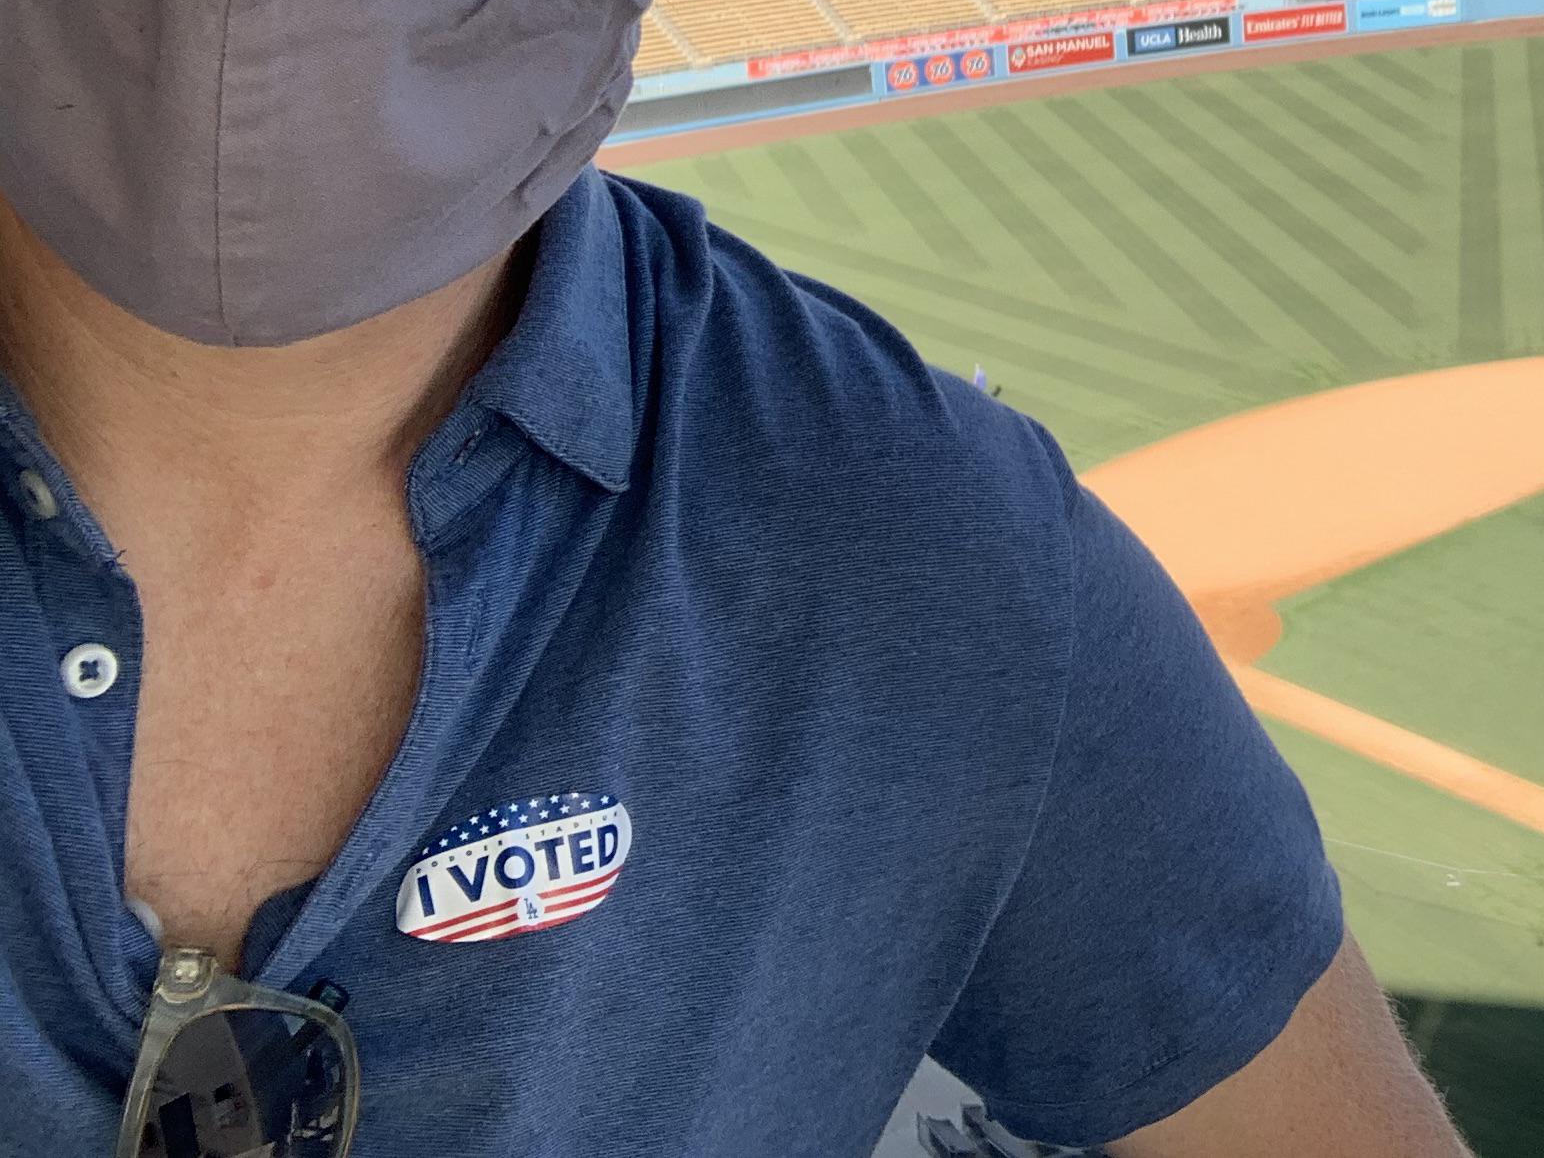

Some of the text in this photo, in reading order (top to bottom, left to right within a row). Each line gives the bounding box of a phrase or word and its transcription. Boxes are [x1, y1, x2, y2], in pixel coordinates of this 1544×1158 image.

[1026, 34, 1110, 58] SAN MANUEL
[1140, 23, 1223, 48] UCLA Health
[417, 823, 619, 918] I VOTED
